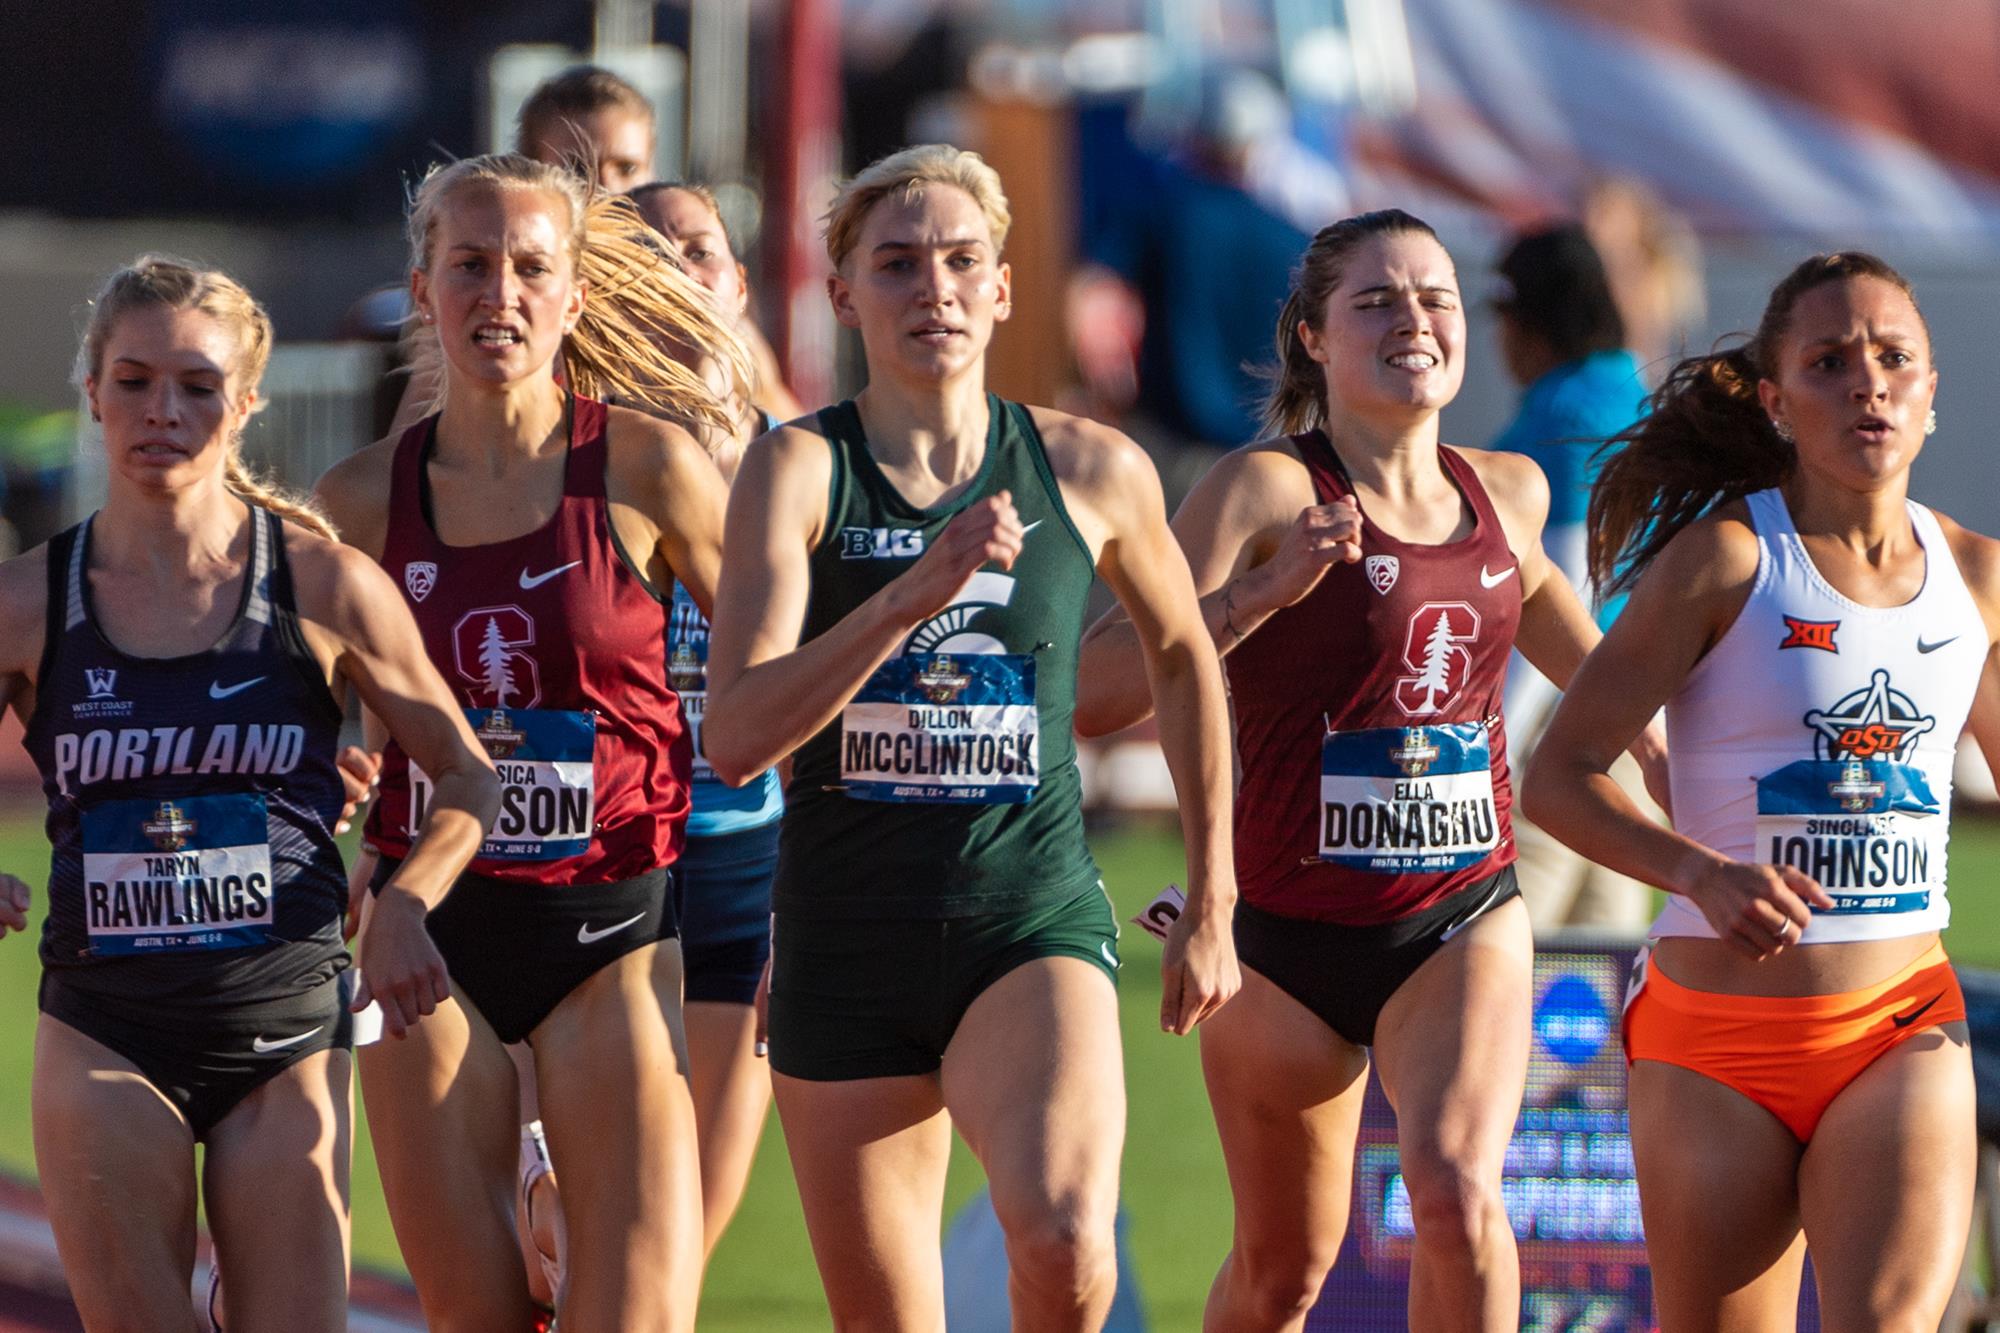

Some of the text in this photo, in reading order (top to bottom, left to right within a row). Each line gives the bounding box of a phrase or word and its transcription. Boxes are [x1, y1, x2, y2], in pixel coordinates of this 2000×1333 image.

[413, 579, 428, 593] 12
[1376, 572, 1392, 585] 12
[1779, 613, 1841, 655] XII
[72, 701, 133, 712] WEST COAST
[908, 709, 972, 729] DILLON
[845, 731, 1035, 775] MCCLINTOCK
[1838, 723, 1904, 757] OSU
[55, 724, 304, 796] PORTLAND
[1395, 783, 1434, 801] ELLA
[415, 781, 588, 837] LSON
[1324, 798, 1494, 849] DONAGHU
[504, 844, 526, 853] JUNE
[144, 856, 199, 878] TARYN
[89, 872, 267, 928] RAWLINGS
